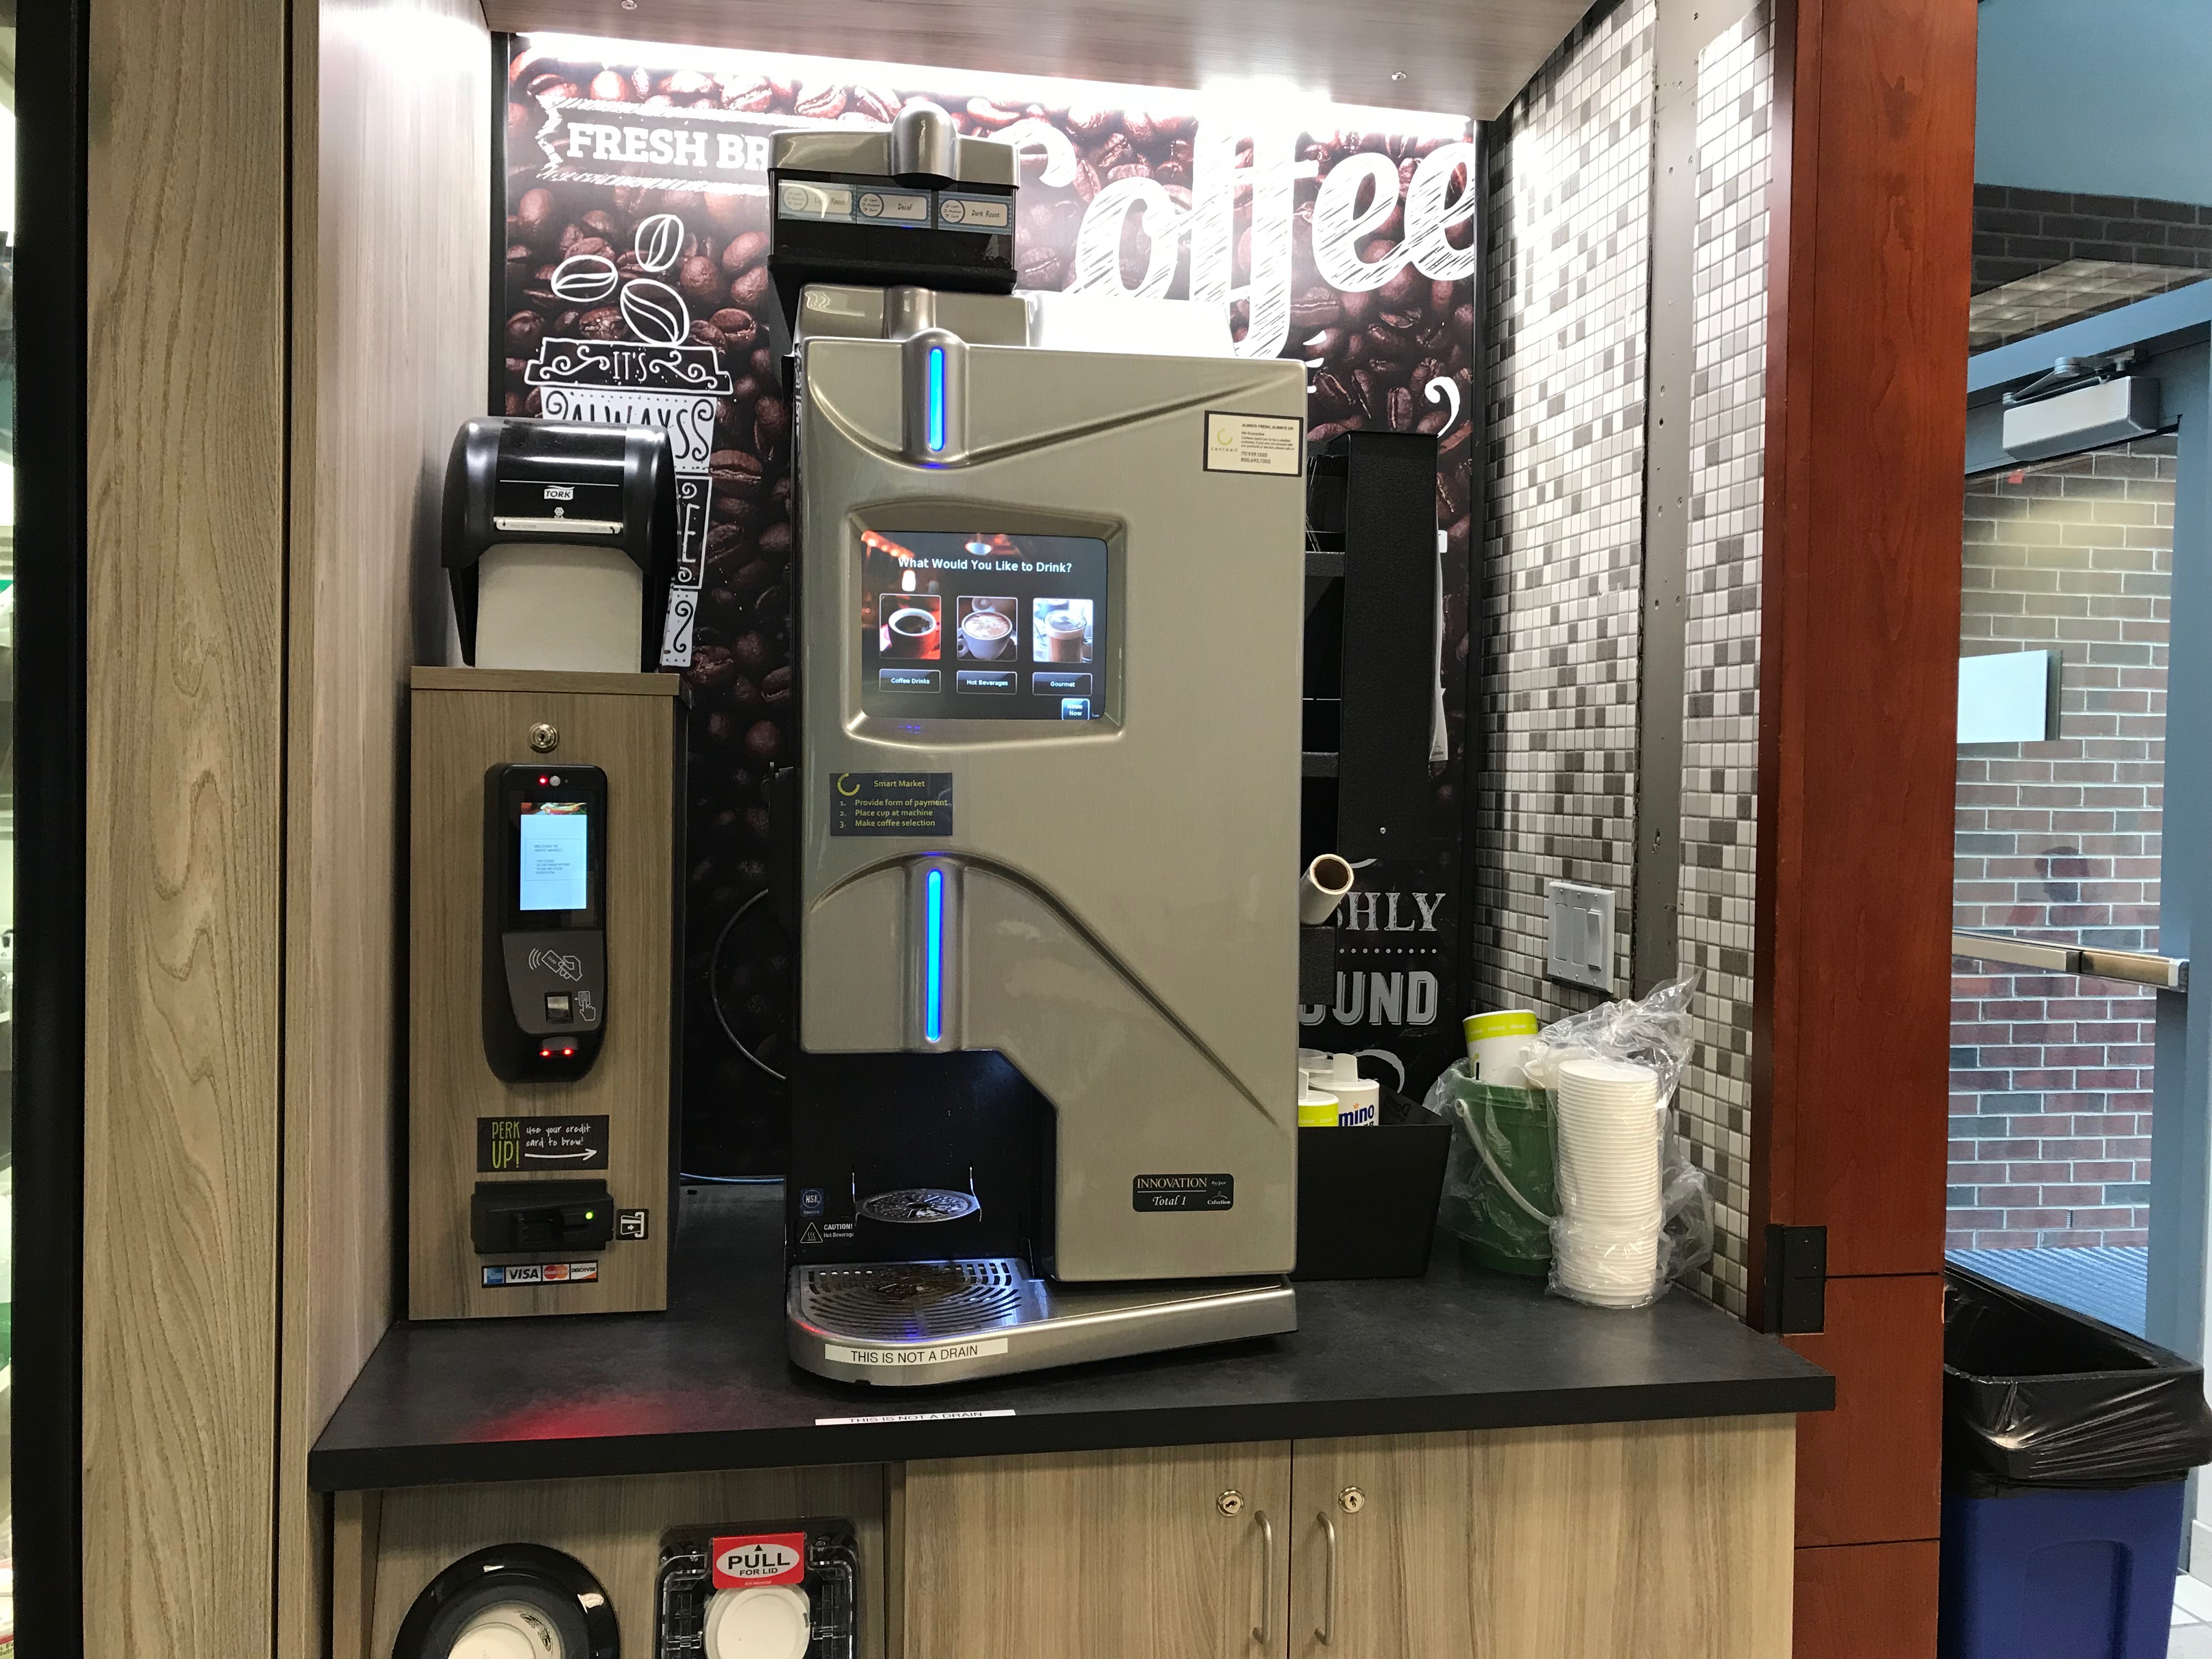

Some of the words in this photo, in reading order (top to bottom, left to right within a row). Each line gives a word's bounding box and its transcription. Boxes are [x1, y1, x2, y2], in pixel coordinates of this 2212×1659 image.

[566, 122, 710, 167] FRESH
[985, 210, 1000, 218] Roast
[985, 107, 1475, 359] offee
[613, 351, 647, 382] IT'S
[898, 558, 929, 569] What
[932, 558, 968, 570] Would
[971, 560, 991, 571] You
[996, 561, 1018, 572] Like
[1022, 563, 1032, 572] to
[1036, 562, 1072, 573] Drink?
[914, 799, 947, 808] payment
[1337, 892, 1446, 932] HLY
[1299, 972, 1438, 1025] UND
[1339, 1104, 1374, 1126] mino
[492, 1121, 520, 1139] PERK
[526, 1126, 541, 1134] use
[546, 1125, 561, 1137] your
[566, 1123, 591, 1133] credit
[526, 1137, 544, 1148] card
[548, 1138, 558, 1146] to
[561, 1137, 584, 1146] brew!
[492, 1140, 520, 1169] UP!
[1137, 1178, 1207, 1188] INNOVATION
[805, 1194, 819, 1203] NSF
[1152, 1195, 1180, 1206] Total
[1181, 1196, 1186, 1205] 1
[509, 1268, 539, 1280] VISA
[851, 1351, 878, 1363] THIS
[882, 1352, 894, 1363] IS
[898, 1351, 924, 1363] NOT
[928, 1351, 937, 1361] A
[941, 1345, 978, 1359] DRAIN
[728, 1553, 791, 1570] PULL
